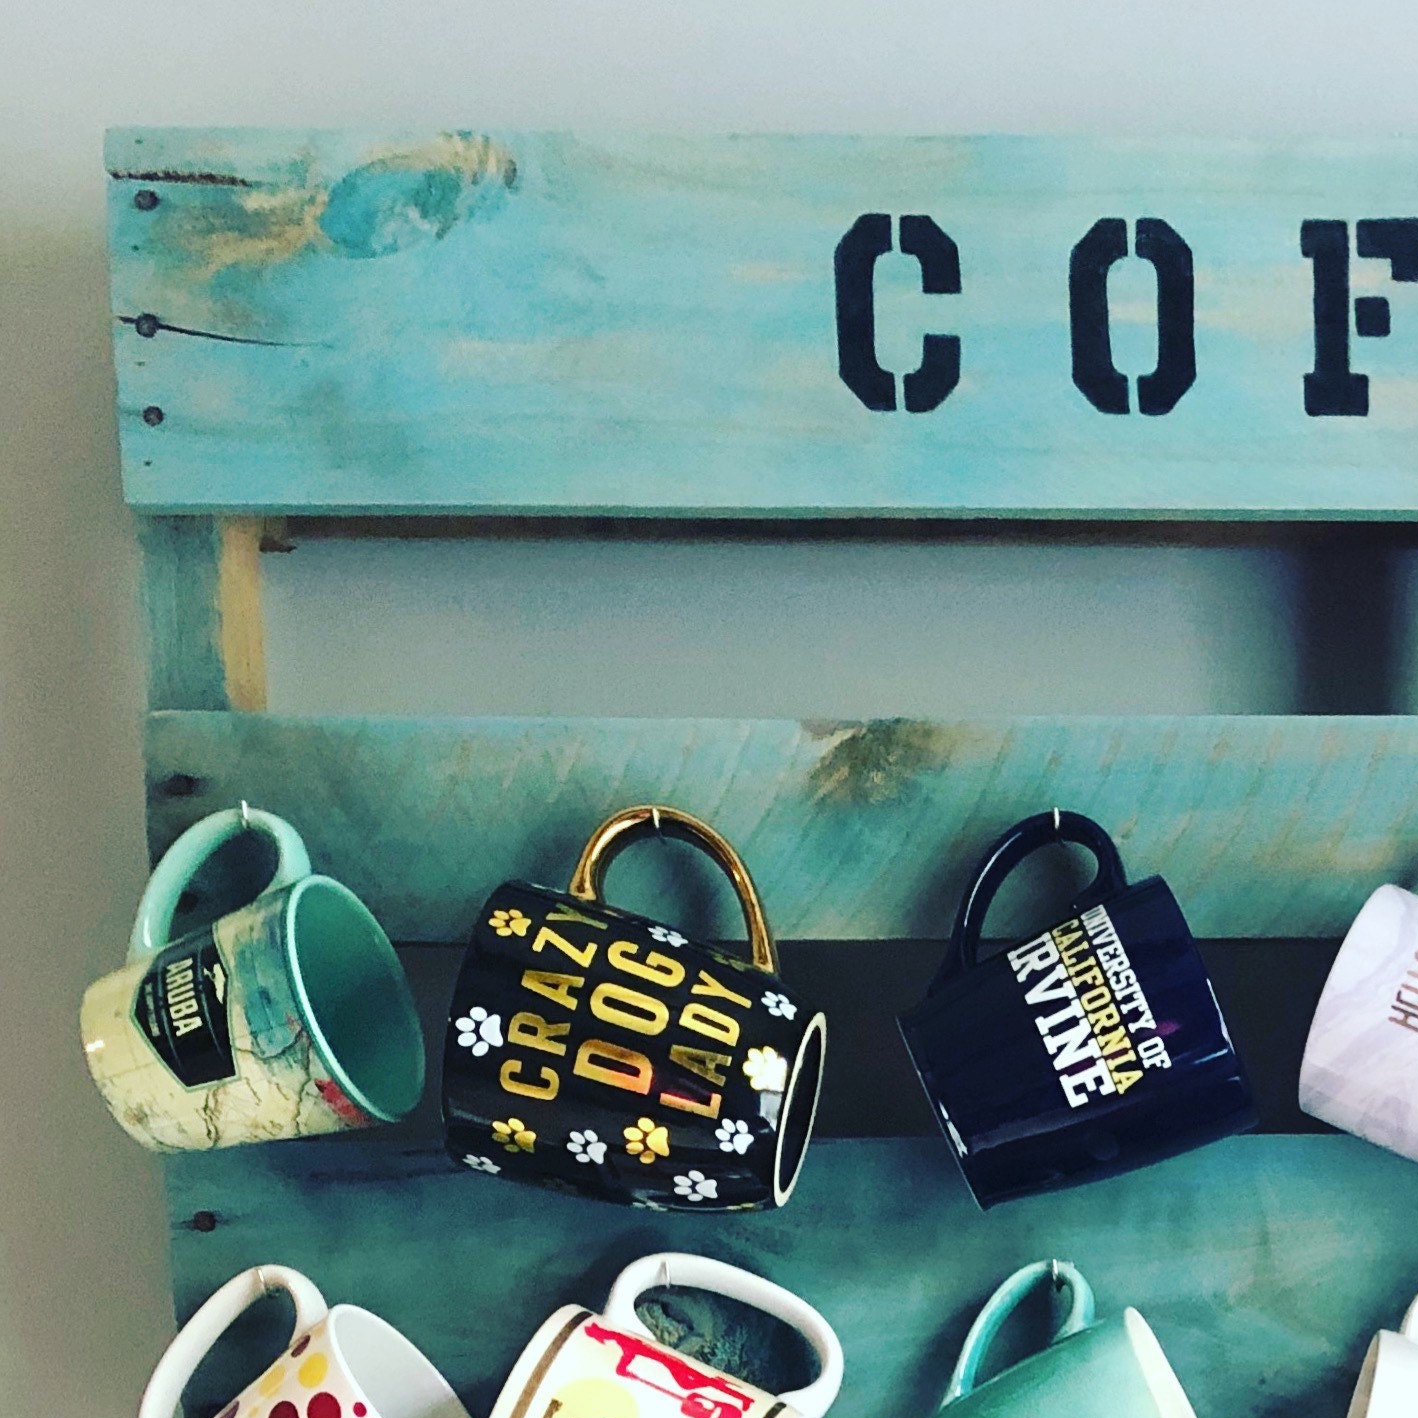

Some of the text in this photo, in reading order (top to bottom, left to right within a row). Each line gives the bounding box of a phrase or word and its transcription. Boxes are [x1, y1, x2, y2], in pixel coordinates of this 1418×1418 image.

[166, 957, 203, 1037] ARUBA
[500, 903, 608, 1101] CRAZY
[573, 940, 686, 1095] DOG
[659, 970, 752, 1120] LADY
[1007, 931, 1117, 1108] IRVINE
[1051, 918, 1144, 1095] CALIFORNIA
[1081, 904, 1173, 1069] UNIVERSITY OF
